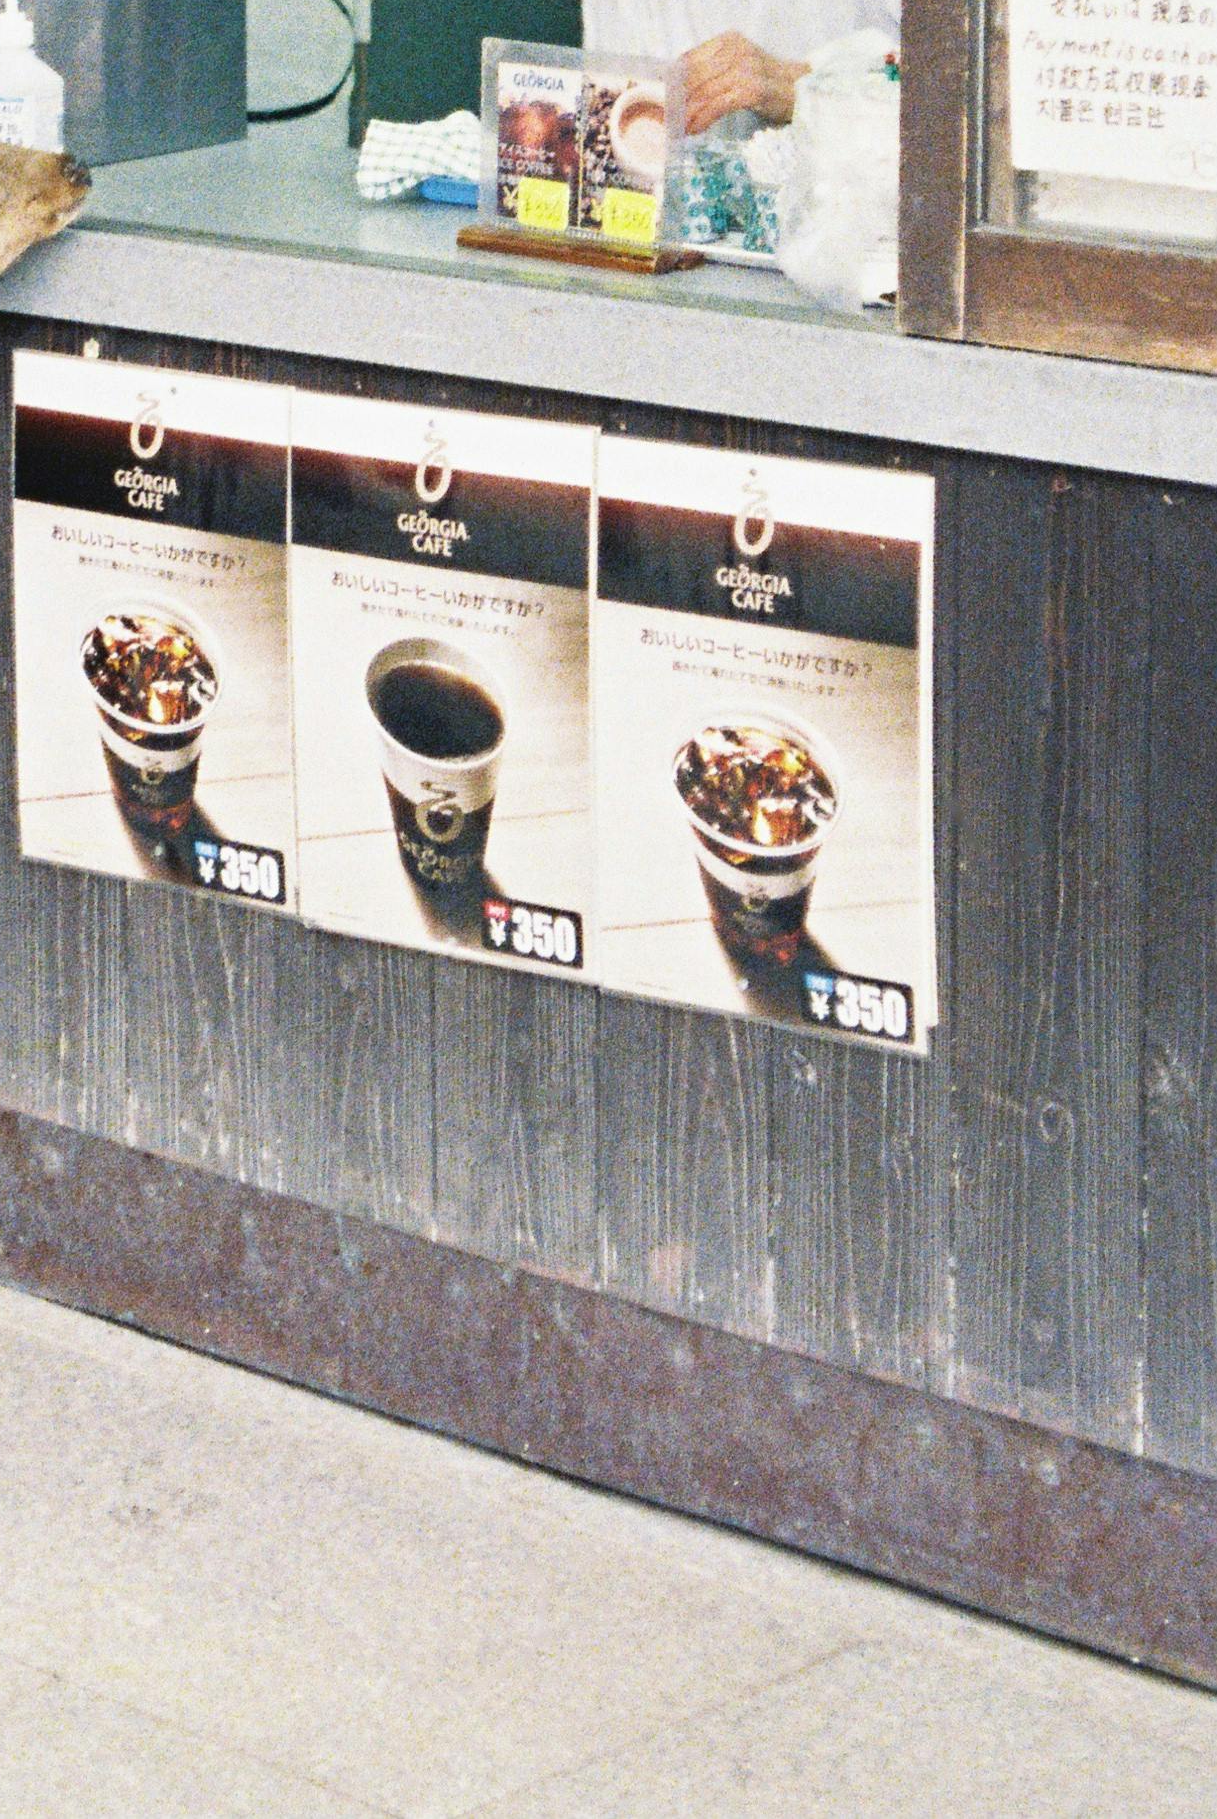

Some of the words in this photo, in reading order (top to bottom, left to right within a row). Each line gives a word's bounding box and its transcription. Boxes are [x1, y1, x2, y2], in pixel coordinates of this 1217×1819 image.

[112, 466, 180, 498] GEORGIA
[126, 489, 165, 512] CAFE
[395, 510, 471, 541] GEORGIA
[410, 533, 453, 558] CAFE
[714, 563, 793, 597] GEORGIA
[730, 588, 775, 614] CAFE
